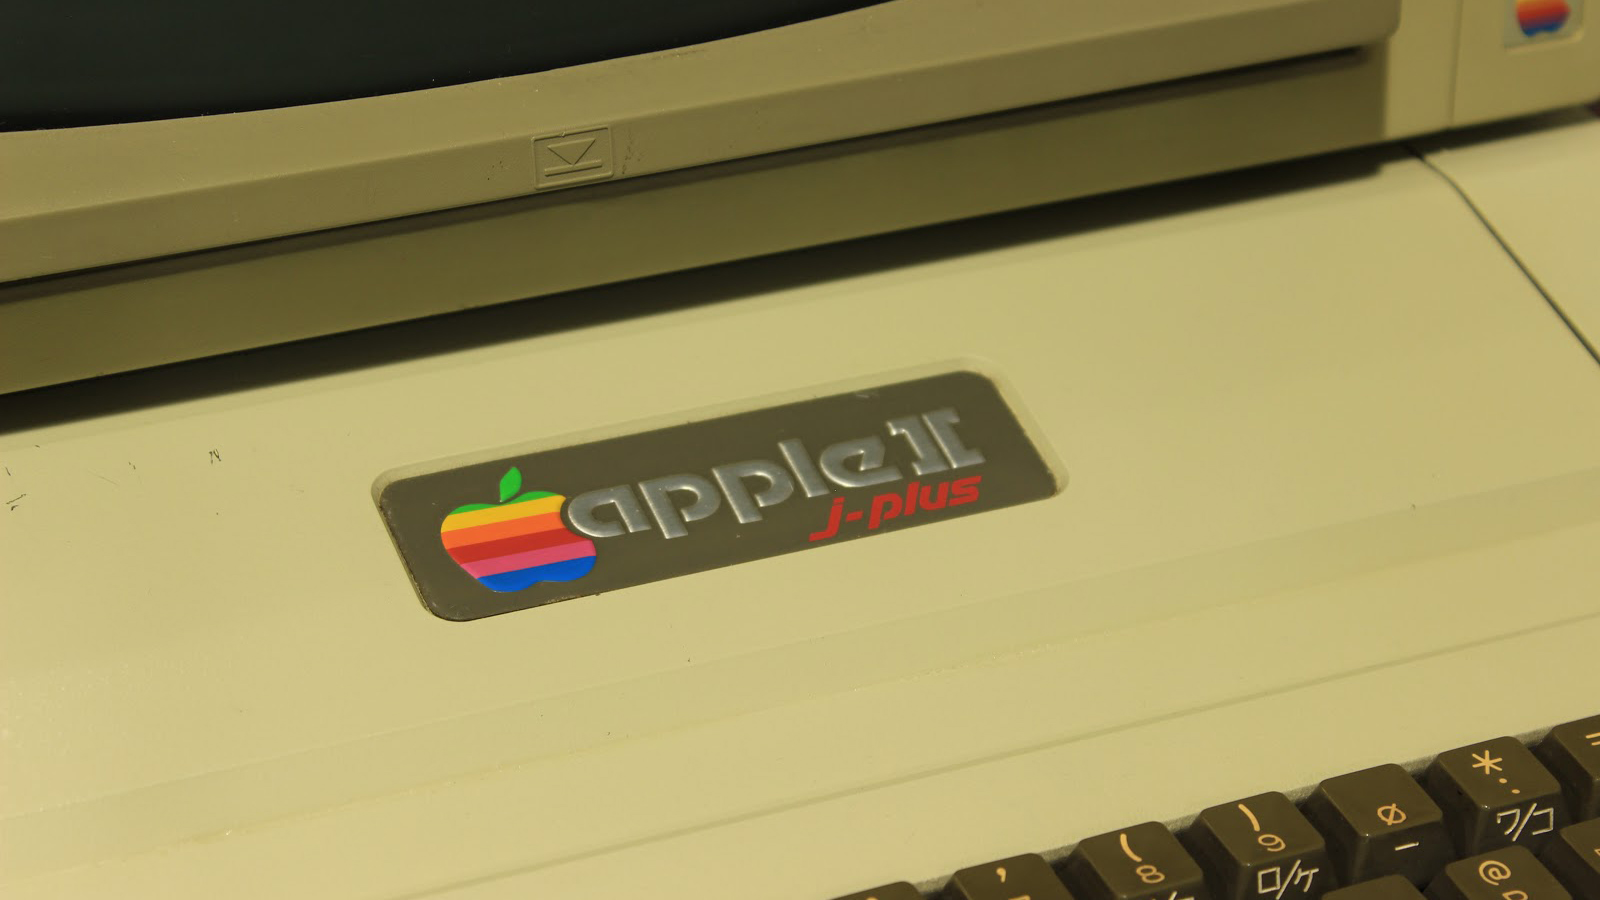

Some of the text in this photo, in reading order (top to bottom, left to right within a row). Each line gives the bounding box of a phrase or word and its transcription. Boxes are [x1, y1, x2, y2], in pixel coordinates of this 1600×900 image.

[568, 436, 903, 540] apple
[808, 475, 982, 542] j-plus
[1257, 834, 1287, 852] 9
[1136, 865, 1165, 884] 8
[1478, 860, 1512, 886] @
